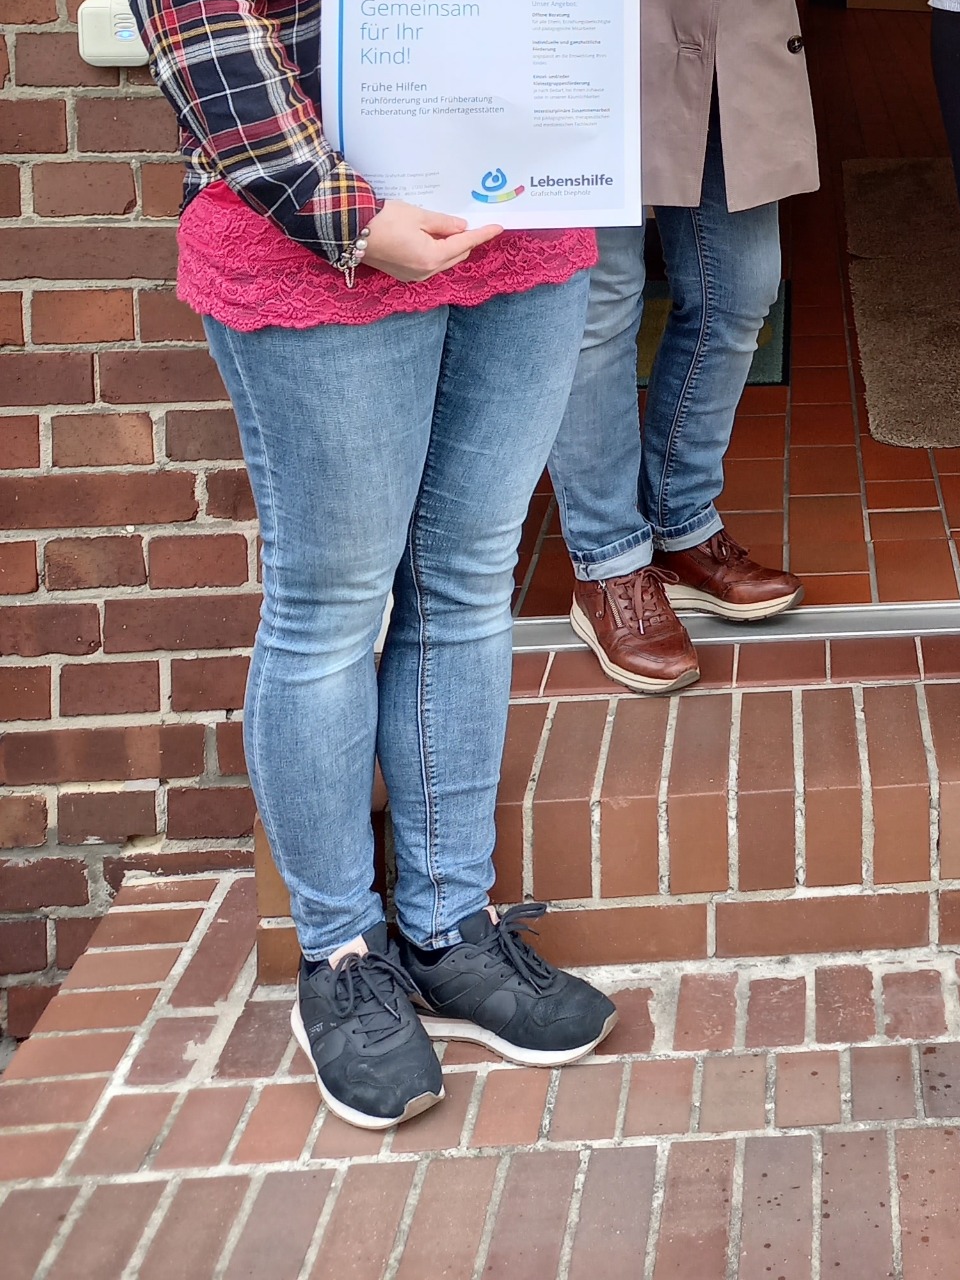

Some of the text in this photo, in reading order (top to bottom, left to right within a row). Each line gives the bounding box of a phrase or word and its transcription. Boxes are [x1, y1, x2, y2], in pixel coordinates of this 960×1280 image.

[360, 22, 424, 41] für Ihr
[360, 46, 411, 65] Kind!
[360, 81, 427, 92] Frühe Hilfen
[360, 95, 493, 106] Frühförderung und Frühberatung
[360, 106, 504, 117] Fachberatung für Kindertagesstätten
[530, 174, 614, 188] Lebenshilfe
[530, 188, 591, 197] Grafschaft Diepholz
